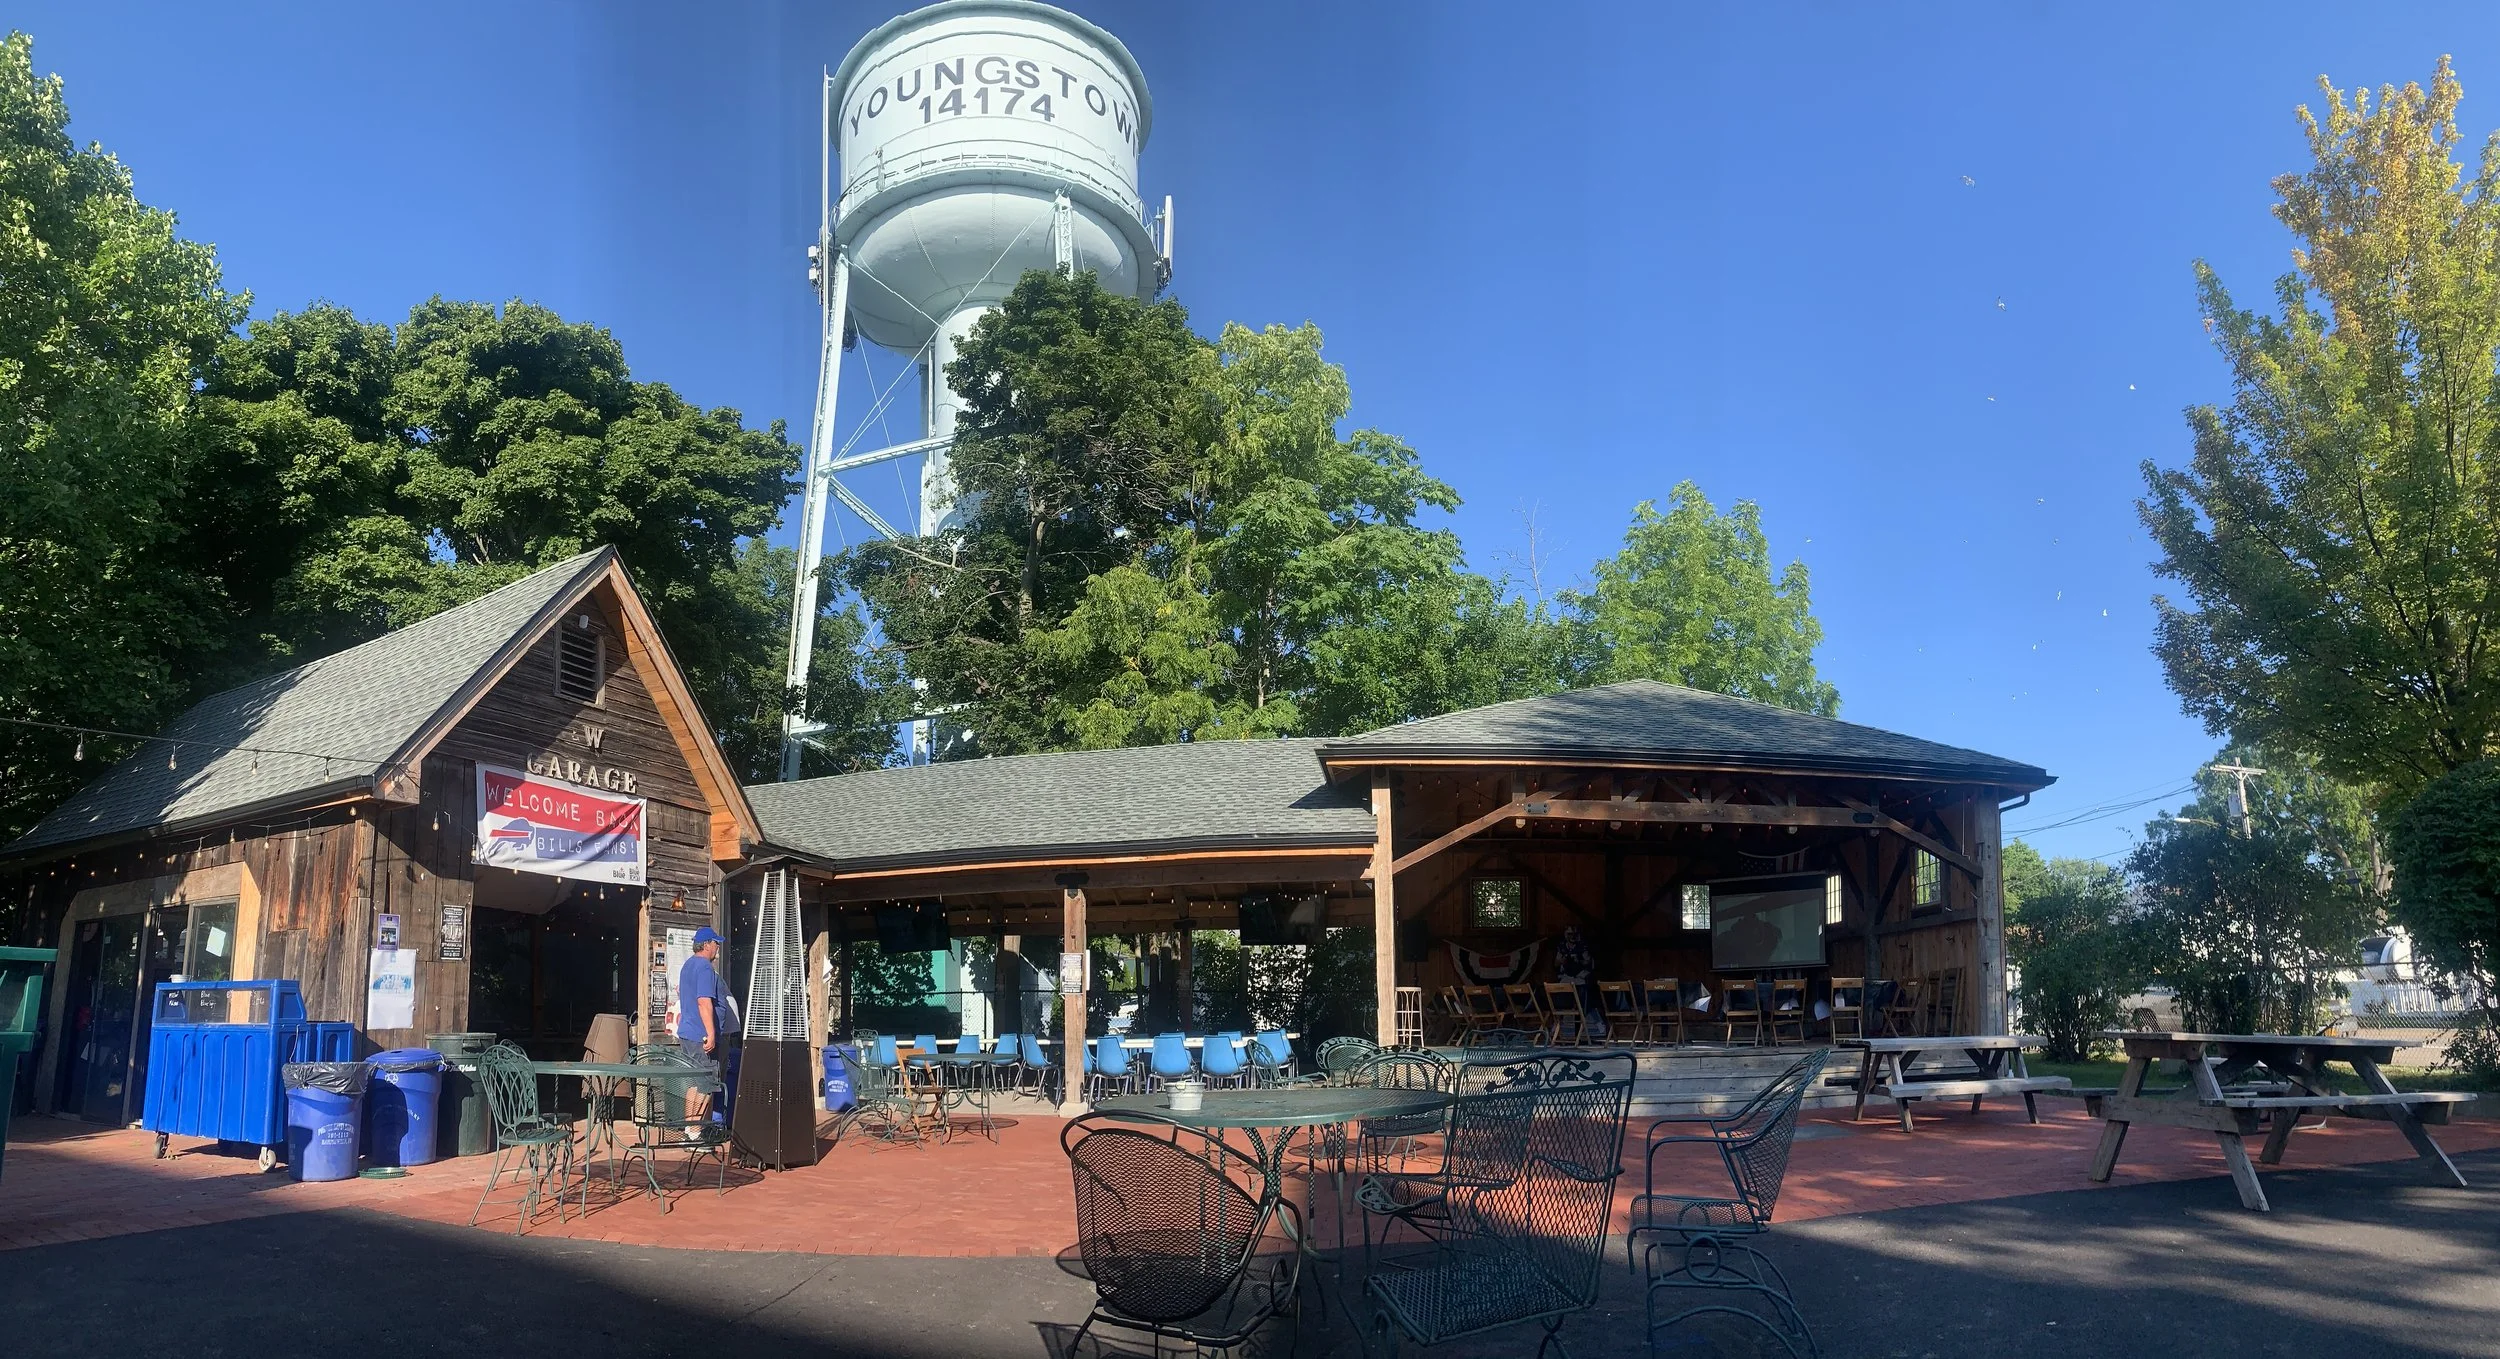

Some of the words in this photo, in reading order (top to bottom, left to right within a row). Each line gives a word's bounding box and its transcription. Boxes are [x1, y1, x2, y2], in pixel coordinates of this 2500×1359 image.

[850, 56, 1136, 158] YOUNGSTOW
[918, 87, 1055, 124] 14174
[527, 753, 638, 794] GARAGE
[486, 782, 581, 822] WELCOME
[536, 837, 583, 854] BILLS
